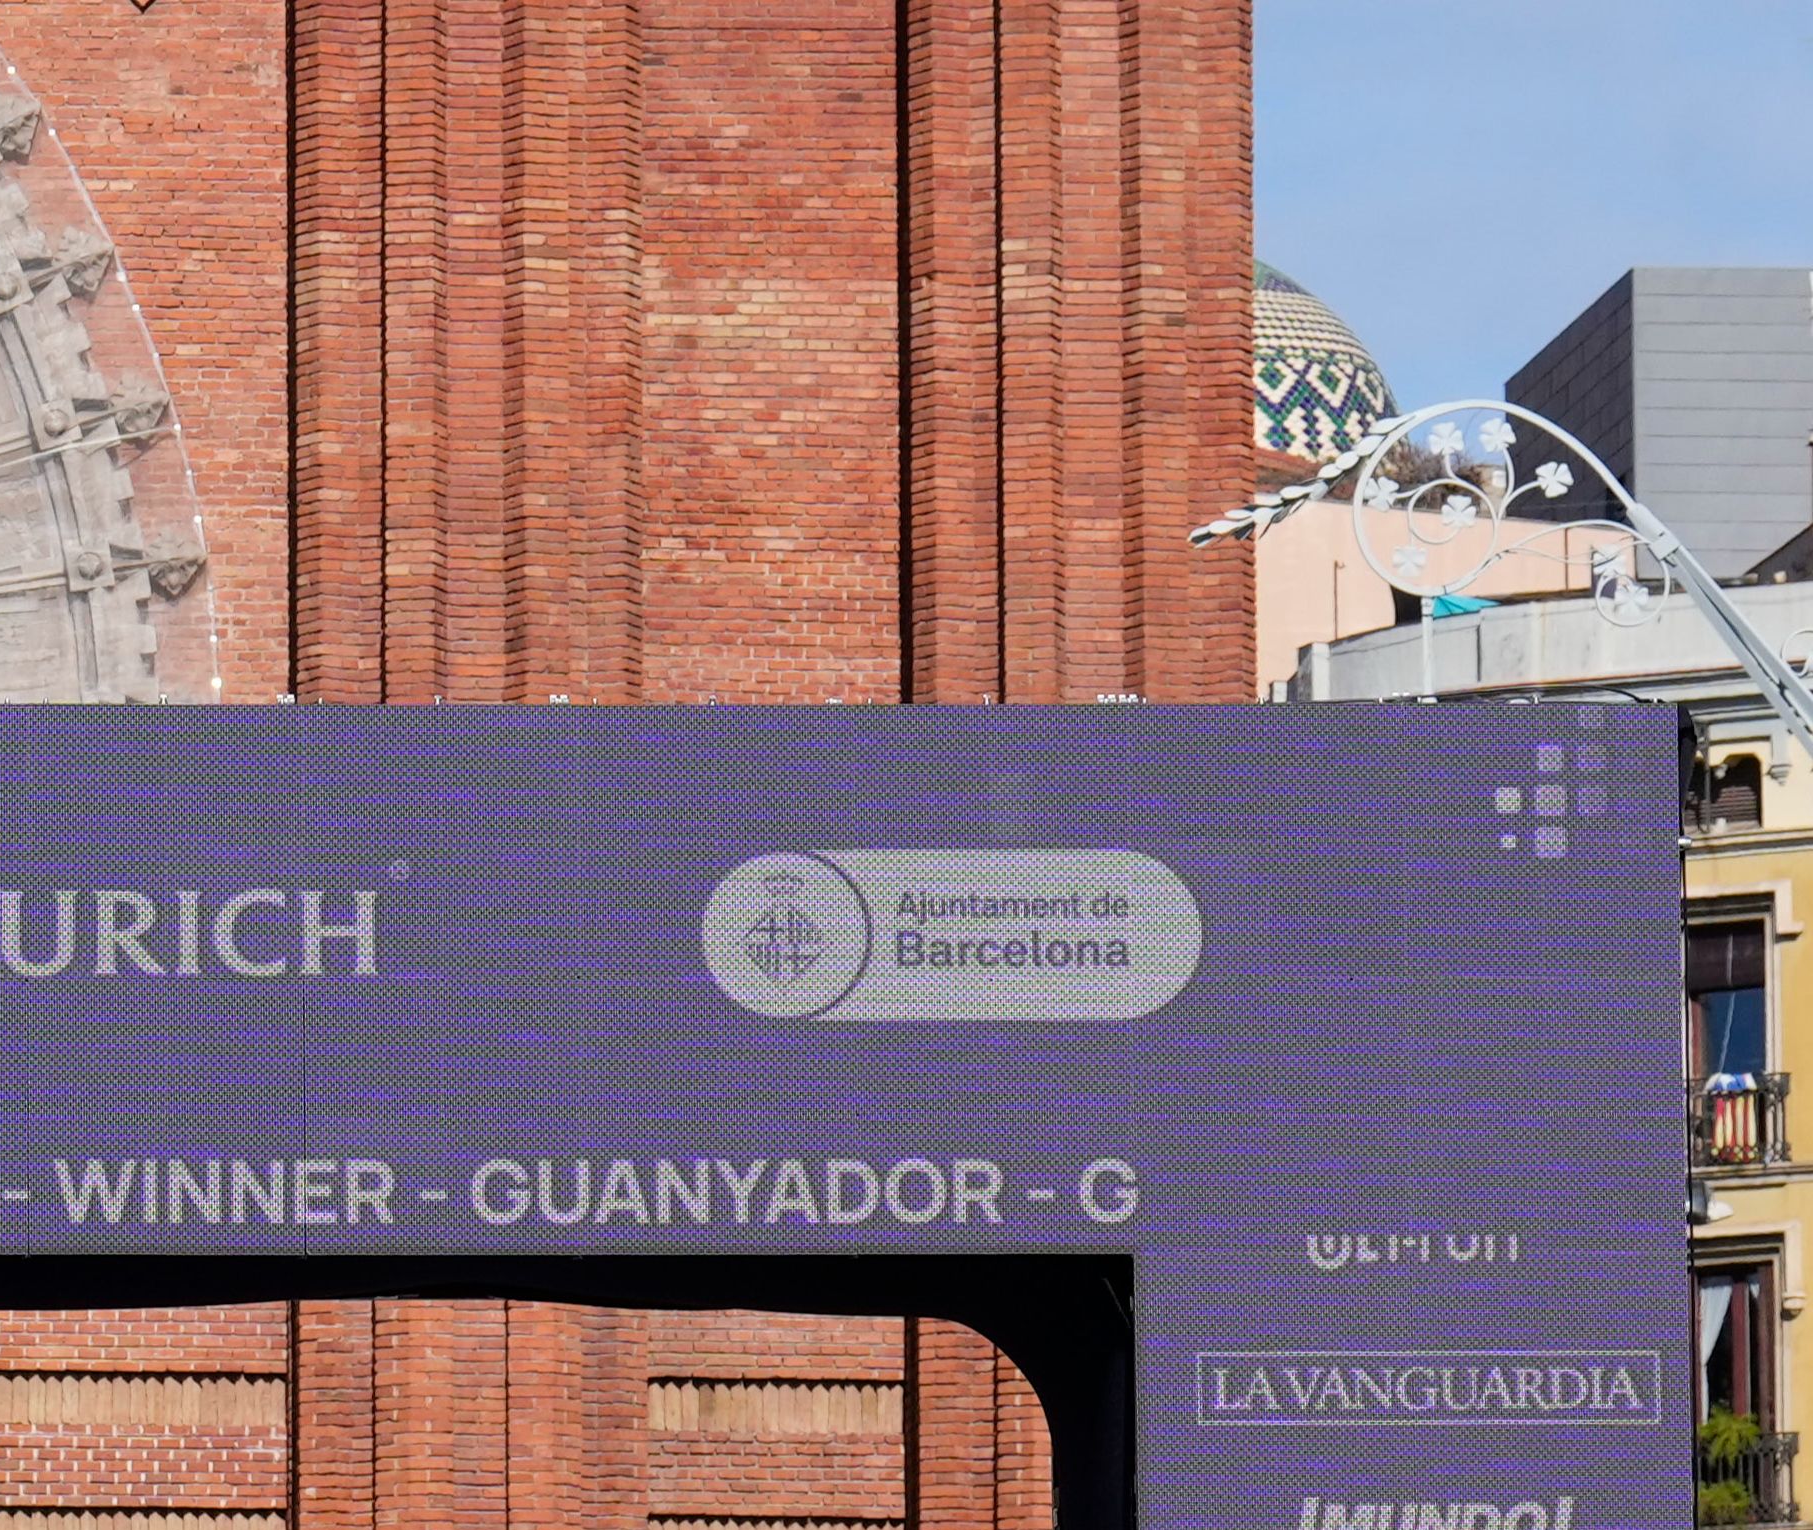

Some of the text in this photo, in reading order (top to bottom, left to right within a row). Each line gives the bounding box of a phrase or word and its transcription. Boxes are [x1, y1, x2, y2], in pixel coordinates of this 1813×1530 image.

[896, 890, 1130, 924] Ajuntament de
[895, 930, 1130, 969] Barcelona
[54, 1157, 396, 1226] WINNER
[471, 1158, 1004, 1226] GUANYADOR
[1214, 1366, 1643, 1412] LA VANGUARDIA
